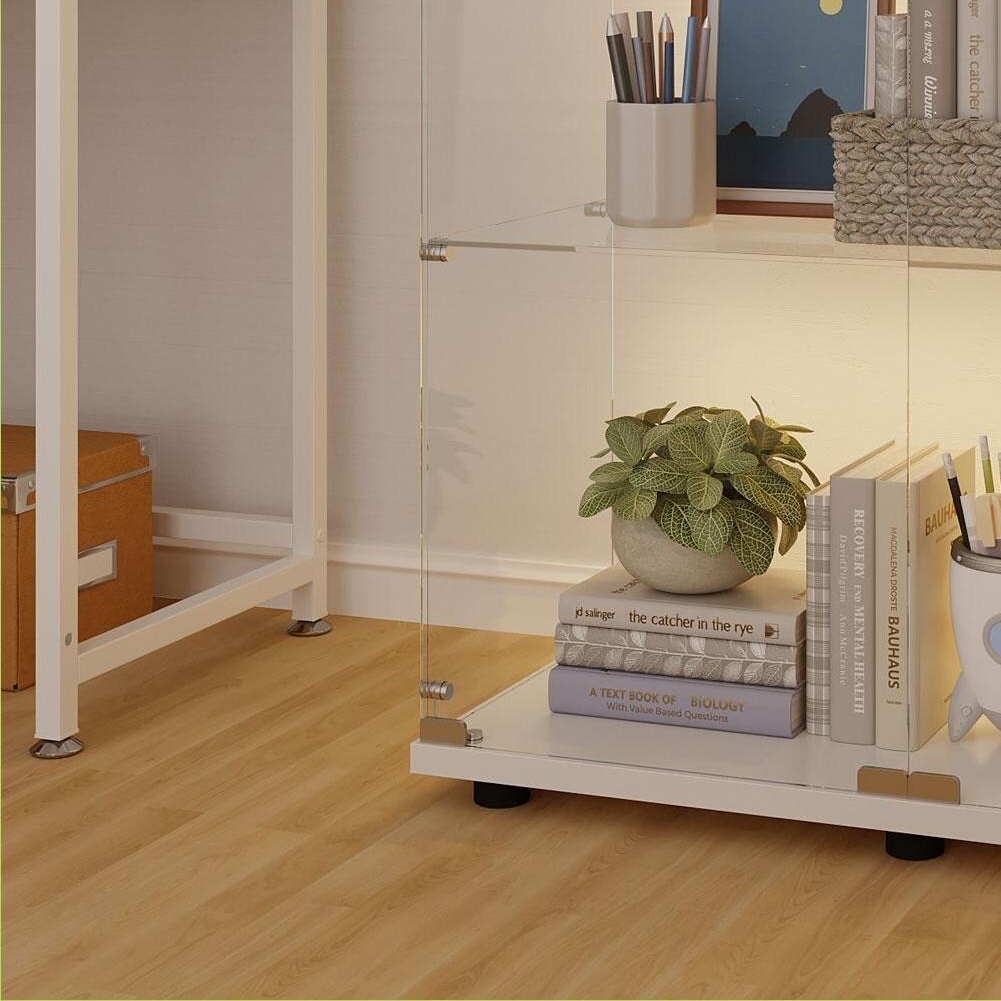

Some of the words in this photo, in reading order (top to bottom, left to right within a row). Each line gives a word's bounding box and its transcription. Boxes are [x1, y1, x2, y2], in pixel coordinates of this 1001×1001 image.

[970, 34, 984, 56] the
[924, 75, 937, 119] Winnie
[969, 60, 984, 112] catcher
[854, 509, 865, 578] RECOVERY
[575, 607, 584, 618] jd
[585, 608, 615, 620] salinger
[629, 610, 647, 624] the
[651, 613, 696, 629] catcher
[698, 616, 709, 630] in
[712, 618, 731, 632] the
[734, 621, 754, 637] rye
[854, 606, 865, 658] MENTAL
[888, 616, 900, 689] BAUHAUS
[590, 687, 598, 696] A
[600, 687, 625, 699] TEXT
[628, 692, 659, 703] BOOK
[662, 694, 677, 705] OF
[691, 696, 744, 712] BIOLOGY
[607, 701, 628, 712] With
[629, 704, 654, 714] Value
[656, 706, 682, 718] Based
[685, 710, 729, 723] Questions
[854, 662, 865, 714] HEALTH
